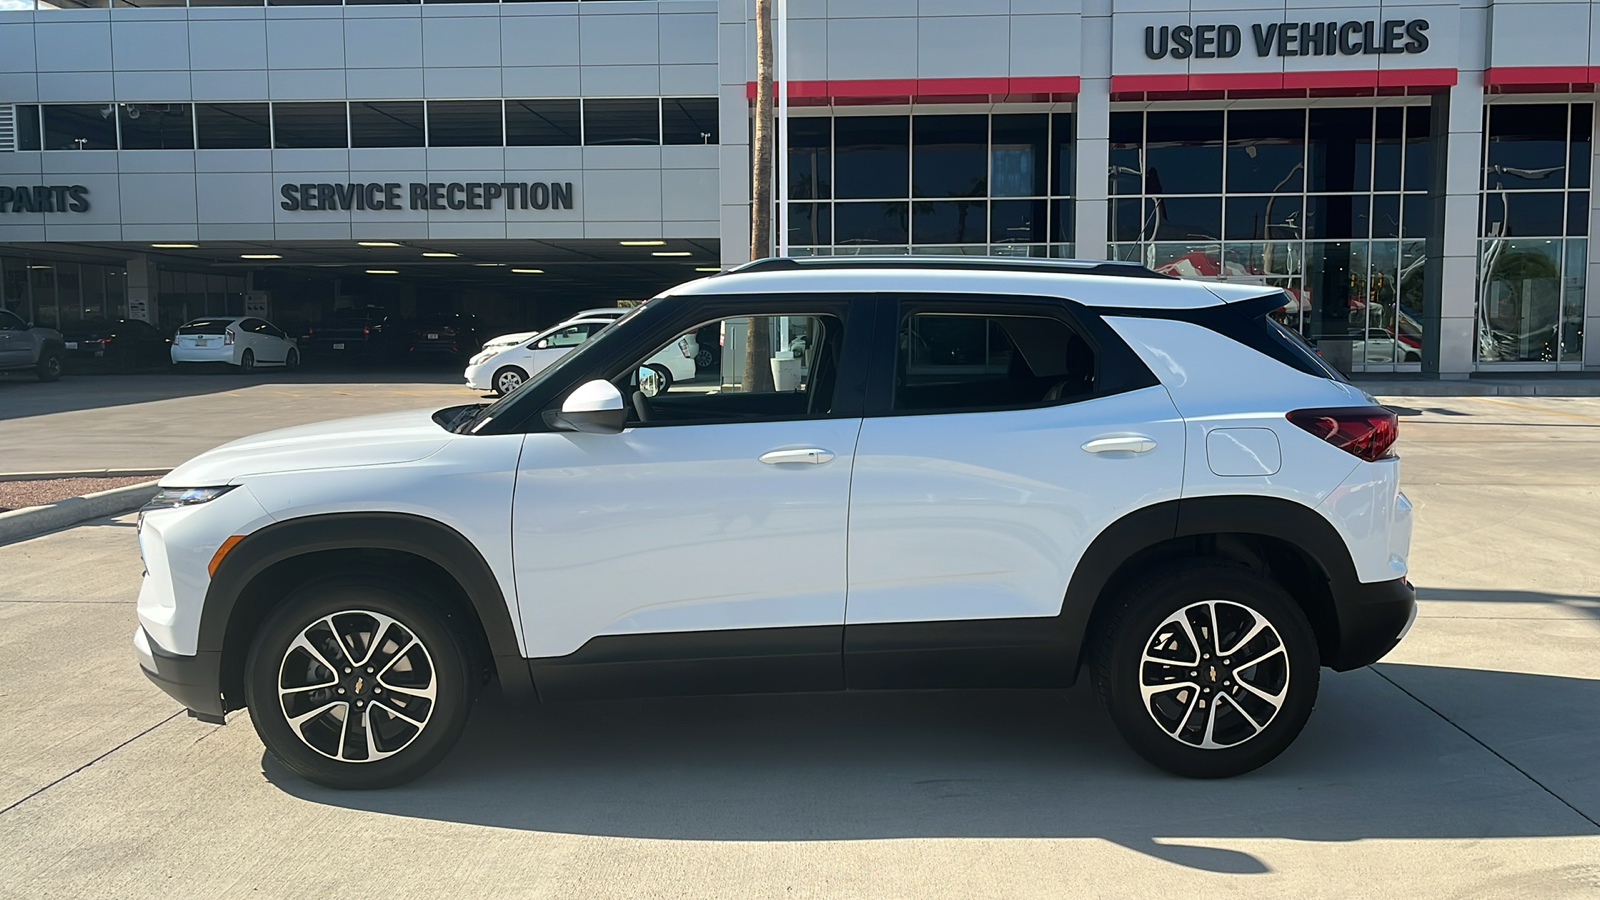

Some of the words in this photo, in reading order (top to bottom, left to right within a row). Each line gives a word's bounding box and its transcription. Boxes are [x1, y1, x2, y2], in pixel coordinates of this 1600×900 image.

[1145, 25, 1241, 59] USED
[1252, 19, 1429, 57] VEHICLES
[0, 185, 89, 213] PARTS
[280, 183, 402, 211] SERVICE
[409, 182, 573, 210] RECEPTION
